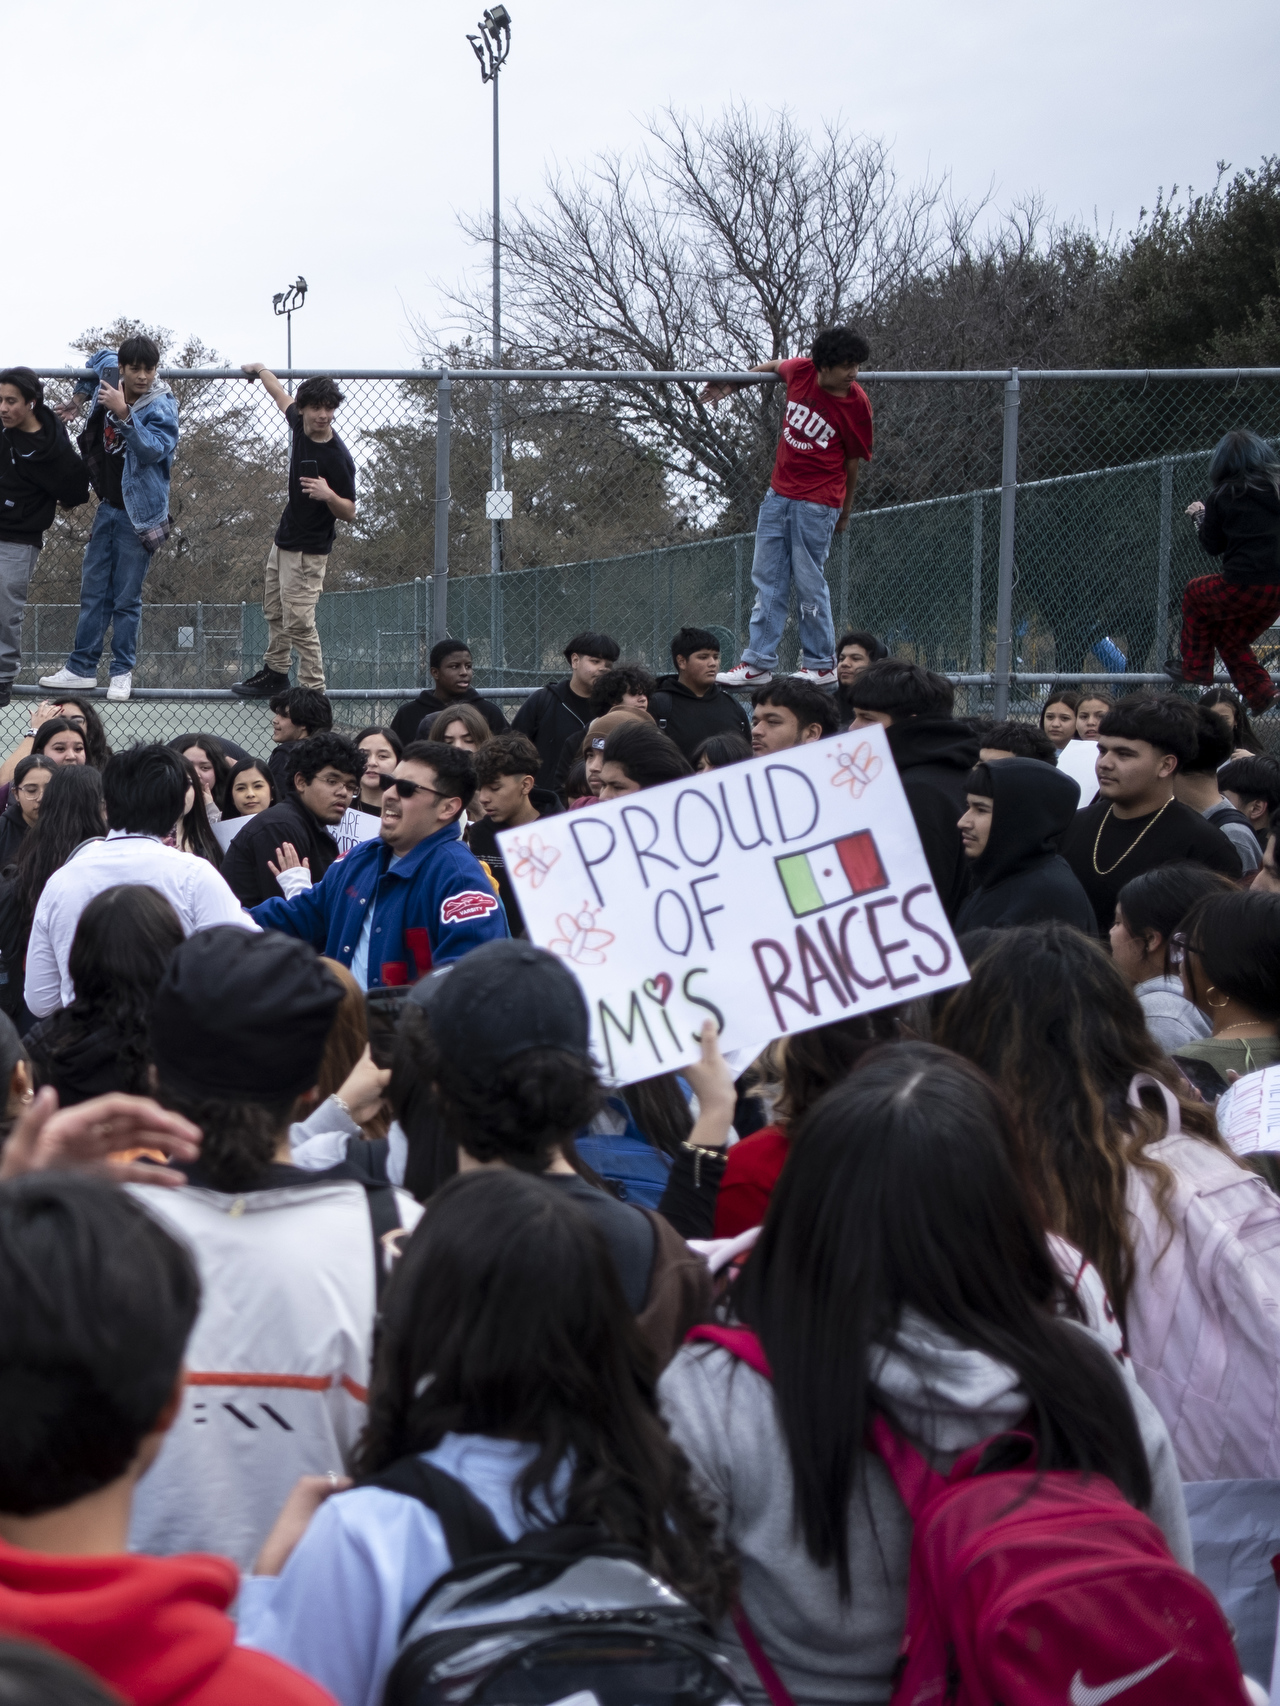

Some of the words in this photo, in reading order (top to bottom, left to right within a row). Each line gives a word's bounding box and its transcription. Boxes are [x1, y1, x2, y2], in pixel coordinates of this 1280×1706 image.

[786, 401, 836, 449] TRUE
[569, 763, 819, 907] PROUD
[459, 906, 483, 916] VARSITY
[655, 873, 725, 957] OF
[751, 884, 952, 1032] RAICES
